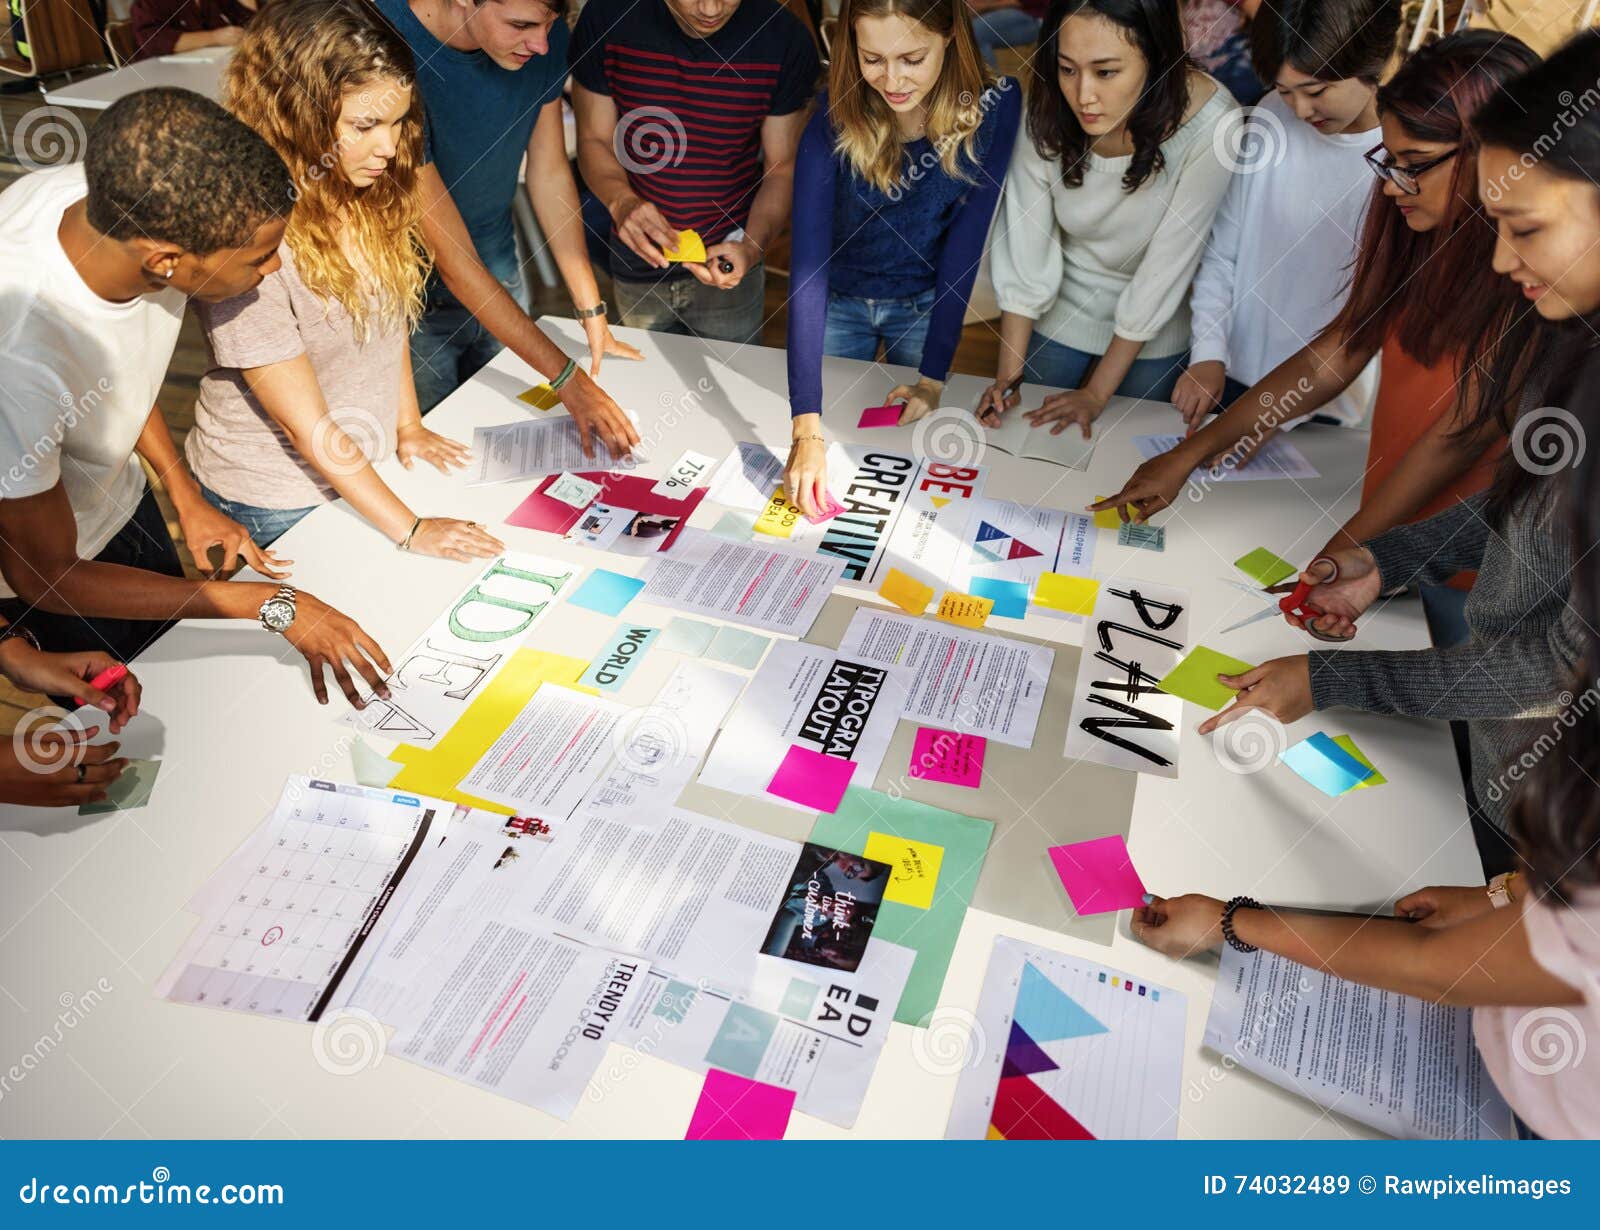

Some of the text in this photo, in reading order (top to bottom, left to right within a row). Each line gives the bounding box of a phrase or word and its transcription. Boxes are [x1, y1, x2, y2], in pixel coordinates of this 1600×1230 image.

[666, 460, 705, 488] 75%
[920, 462, 979, 499] BE
[350, 557, 573, 740] IDEA
[594, 629, 652, 685] WORLD
[1079, 587, 1184, 767] PLAN
[803, 665, 850, 741] LAYOUT
[582, 962, 638, 1041] TRENDY 10
[550, 1027, 583, 1071] COLOUR
